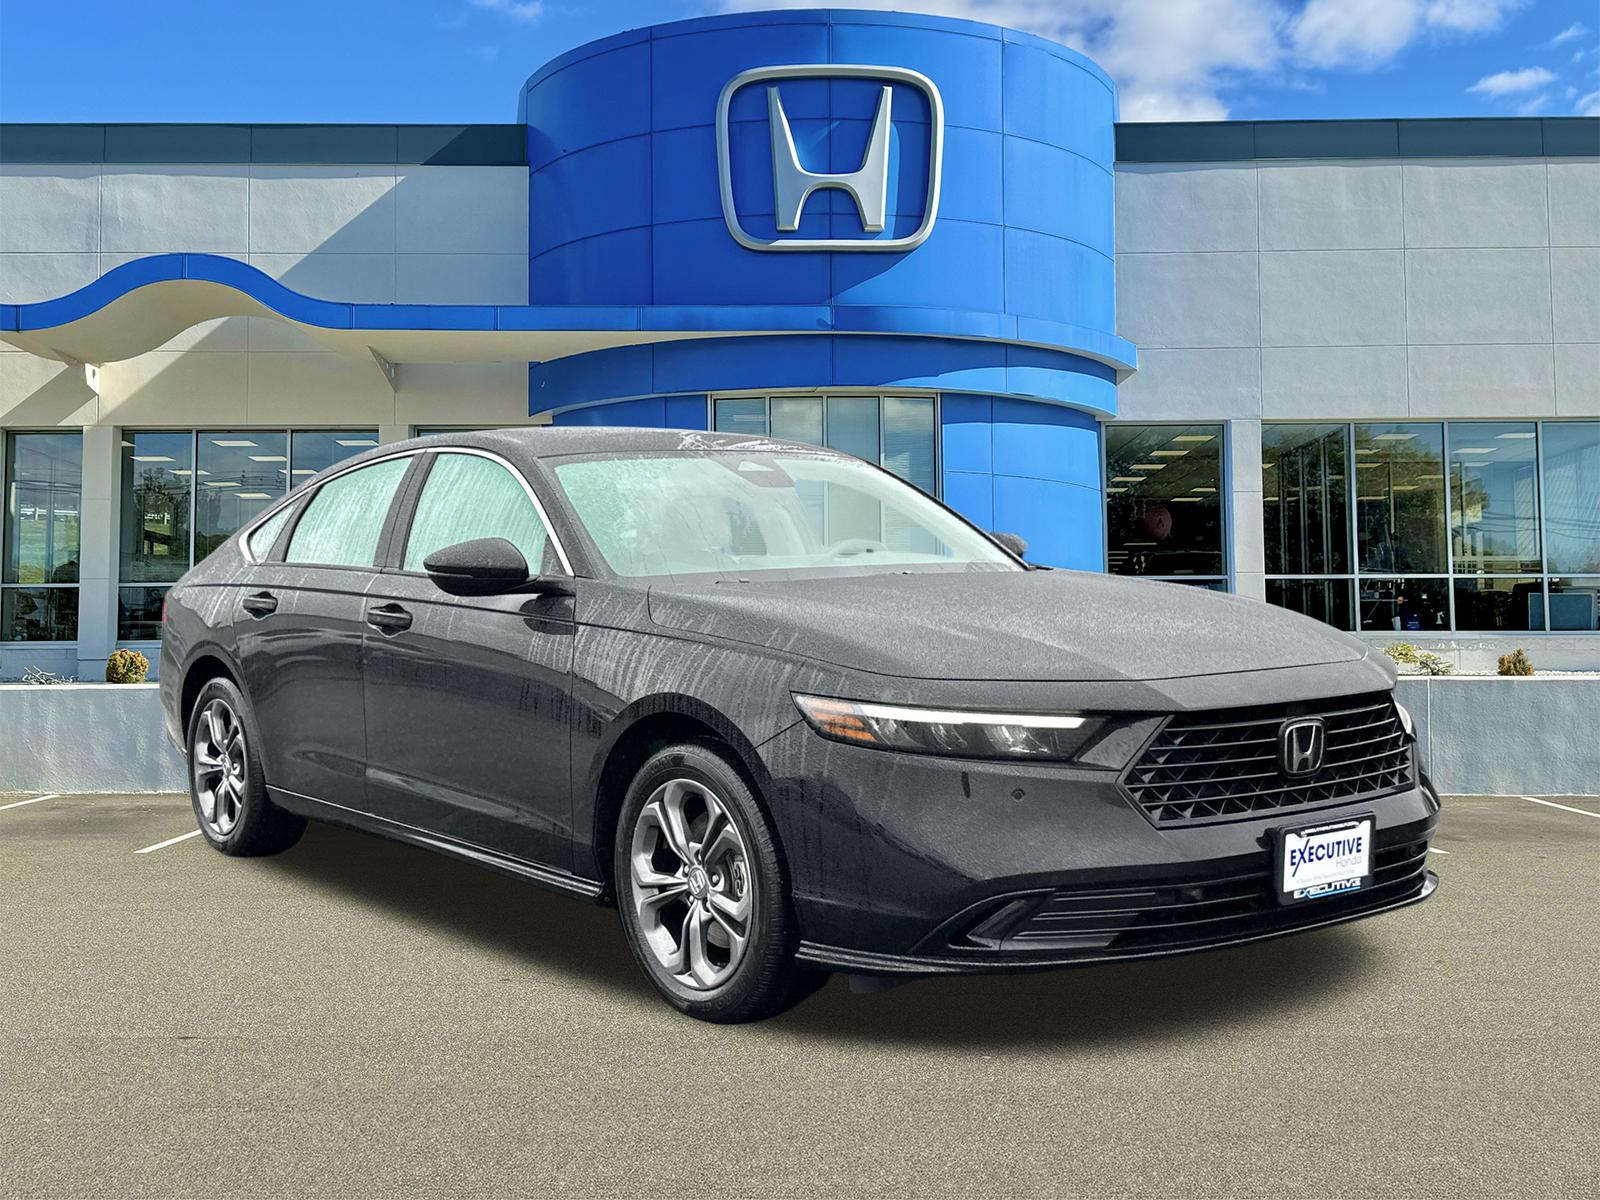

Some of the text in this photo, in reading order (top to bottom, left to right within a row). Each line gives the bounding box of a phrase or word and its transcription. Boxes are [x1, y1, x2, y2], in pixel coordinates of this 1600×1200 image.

[1290, 837, 1362, 877] EXECUTIVE
[1336, 855, 1362, 868] Honda
[1294, 878, 1361, 899] EXECUTIVE
